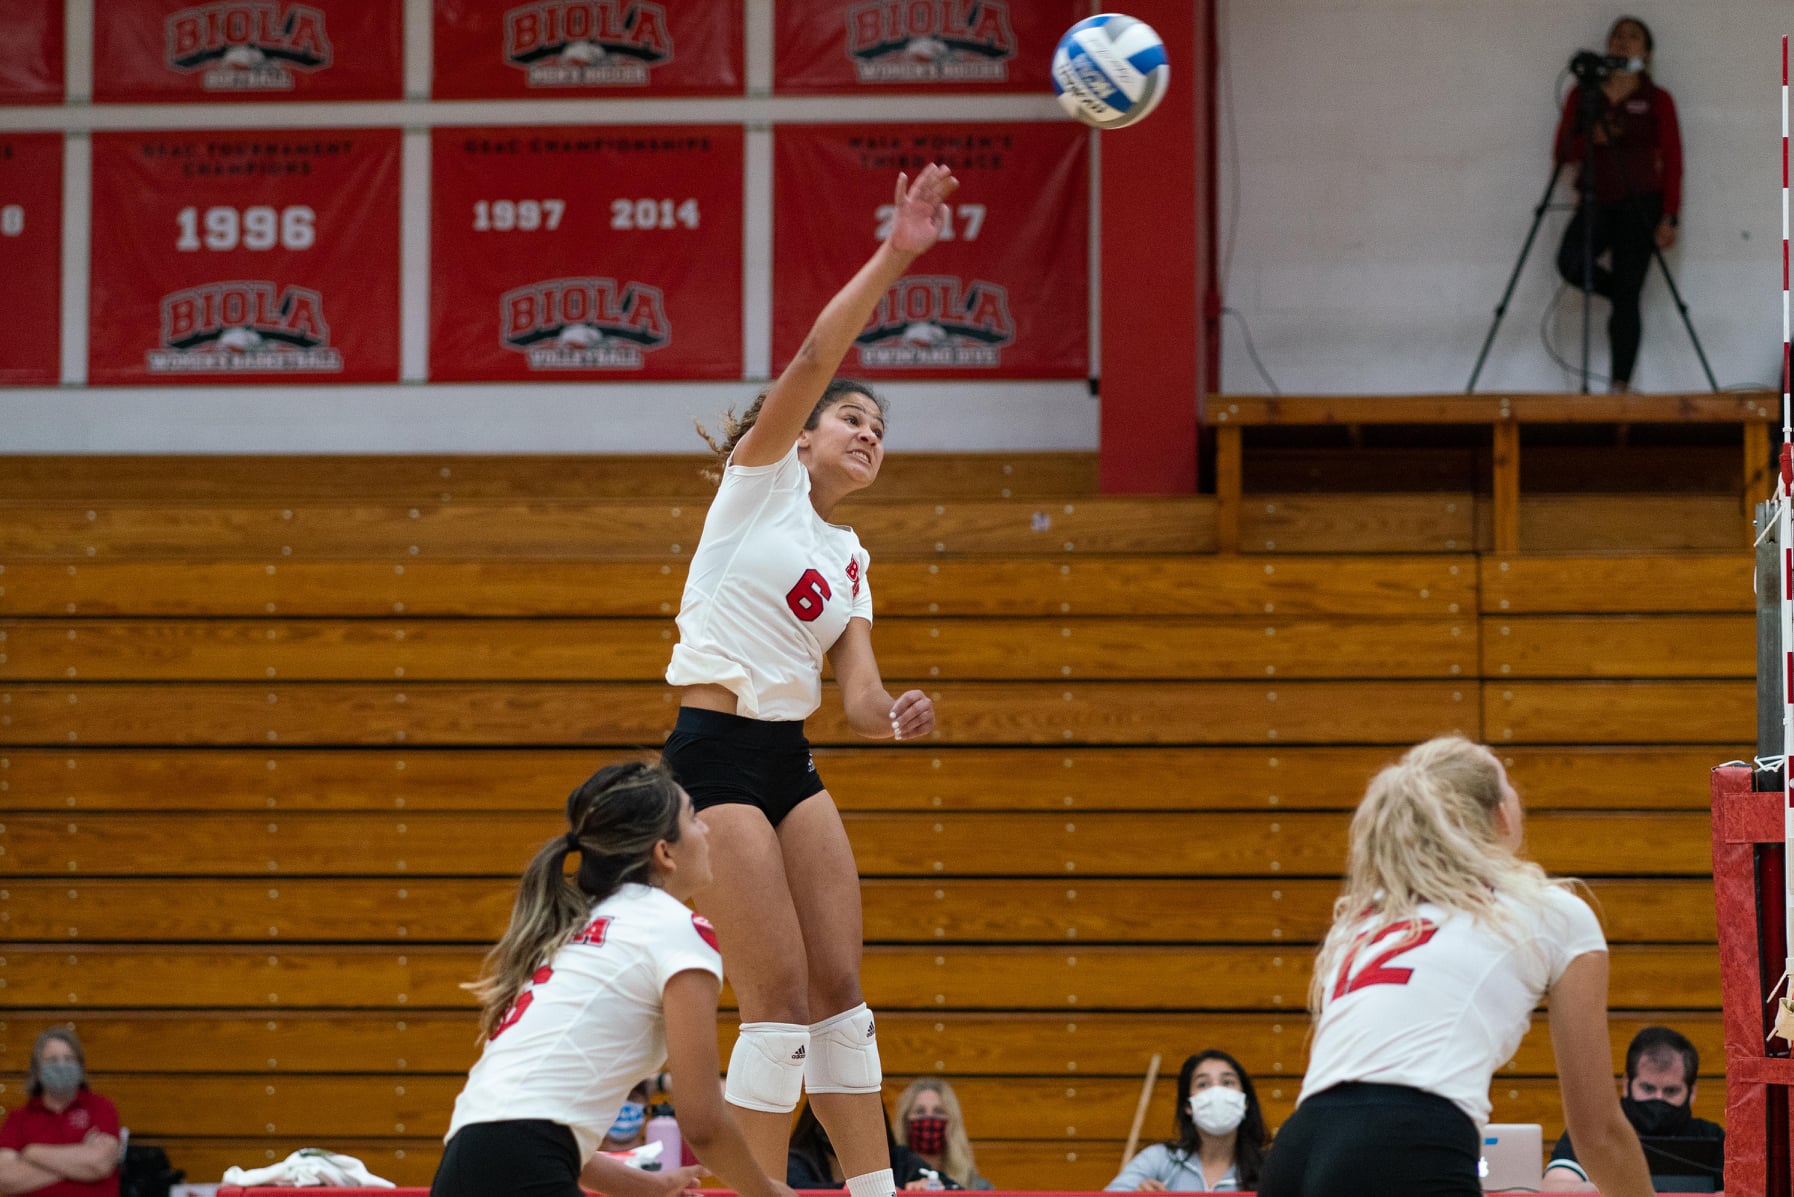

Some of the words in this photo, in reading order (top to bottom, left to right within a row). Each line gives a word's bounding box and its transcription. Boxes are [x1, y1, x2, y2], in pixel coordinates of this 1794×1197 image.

[168, 3, 328, 57] BIOLA
[508, 2, 668, 55] BIOLA
[851, 0, 1012, 52] BIOLA
[176, 205, 316, 251] 1996
[473, 200, 566, 232] 1997
[610, 197, 699, 230] 2014
[875, 204, 986, 240] 217
[165, 284, 324, 340] BIOLA
[505, 279, 668, 335] BIOLA
[866, 280, 1012, 334] IOLA
[530, 348, 642, 368] VOLLEYBALL
[786, 568, 832, 622] 6
[1331, 918, 1440, 1002] 12
